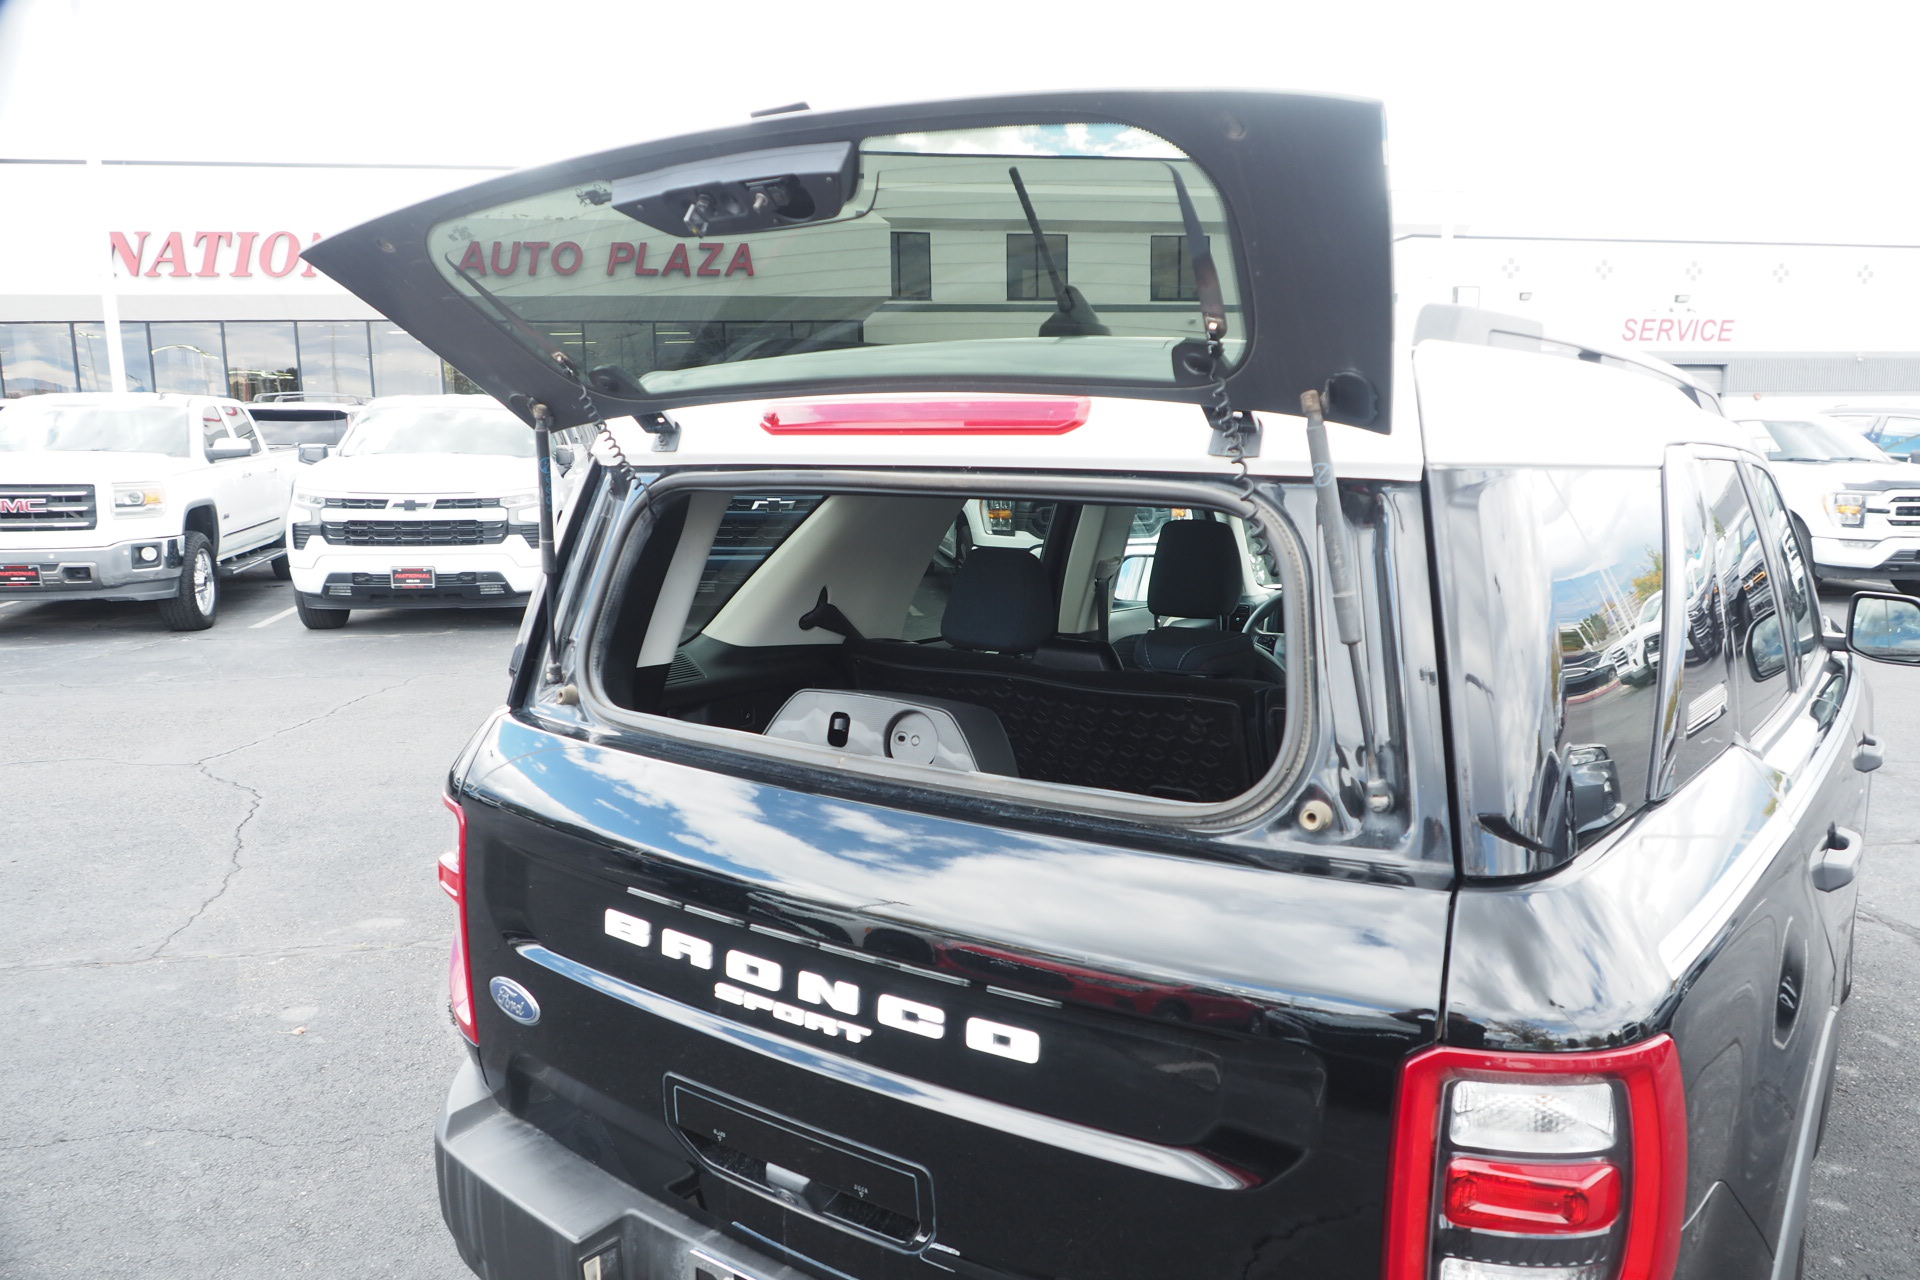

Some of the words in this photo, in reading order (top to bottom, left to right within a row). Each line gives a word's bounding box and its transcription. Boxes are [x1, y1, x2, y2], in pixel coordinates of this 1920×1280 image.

[456, 241, 584, 276] AUTO
[607, 241, 755, 277] PLAZA
[1622, 318, 1735, 342] SERVICE
[0, 498, 47, 513] MC
[497, 985, 525, 1016] Ford
[605, 908, 1041, 1064] BRONCO
[714, 982, 873, 1044] SPORT
